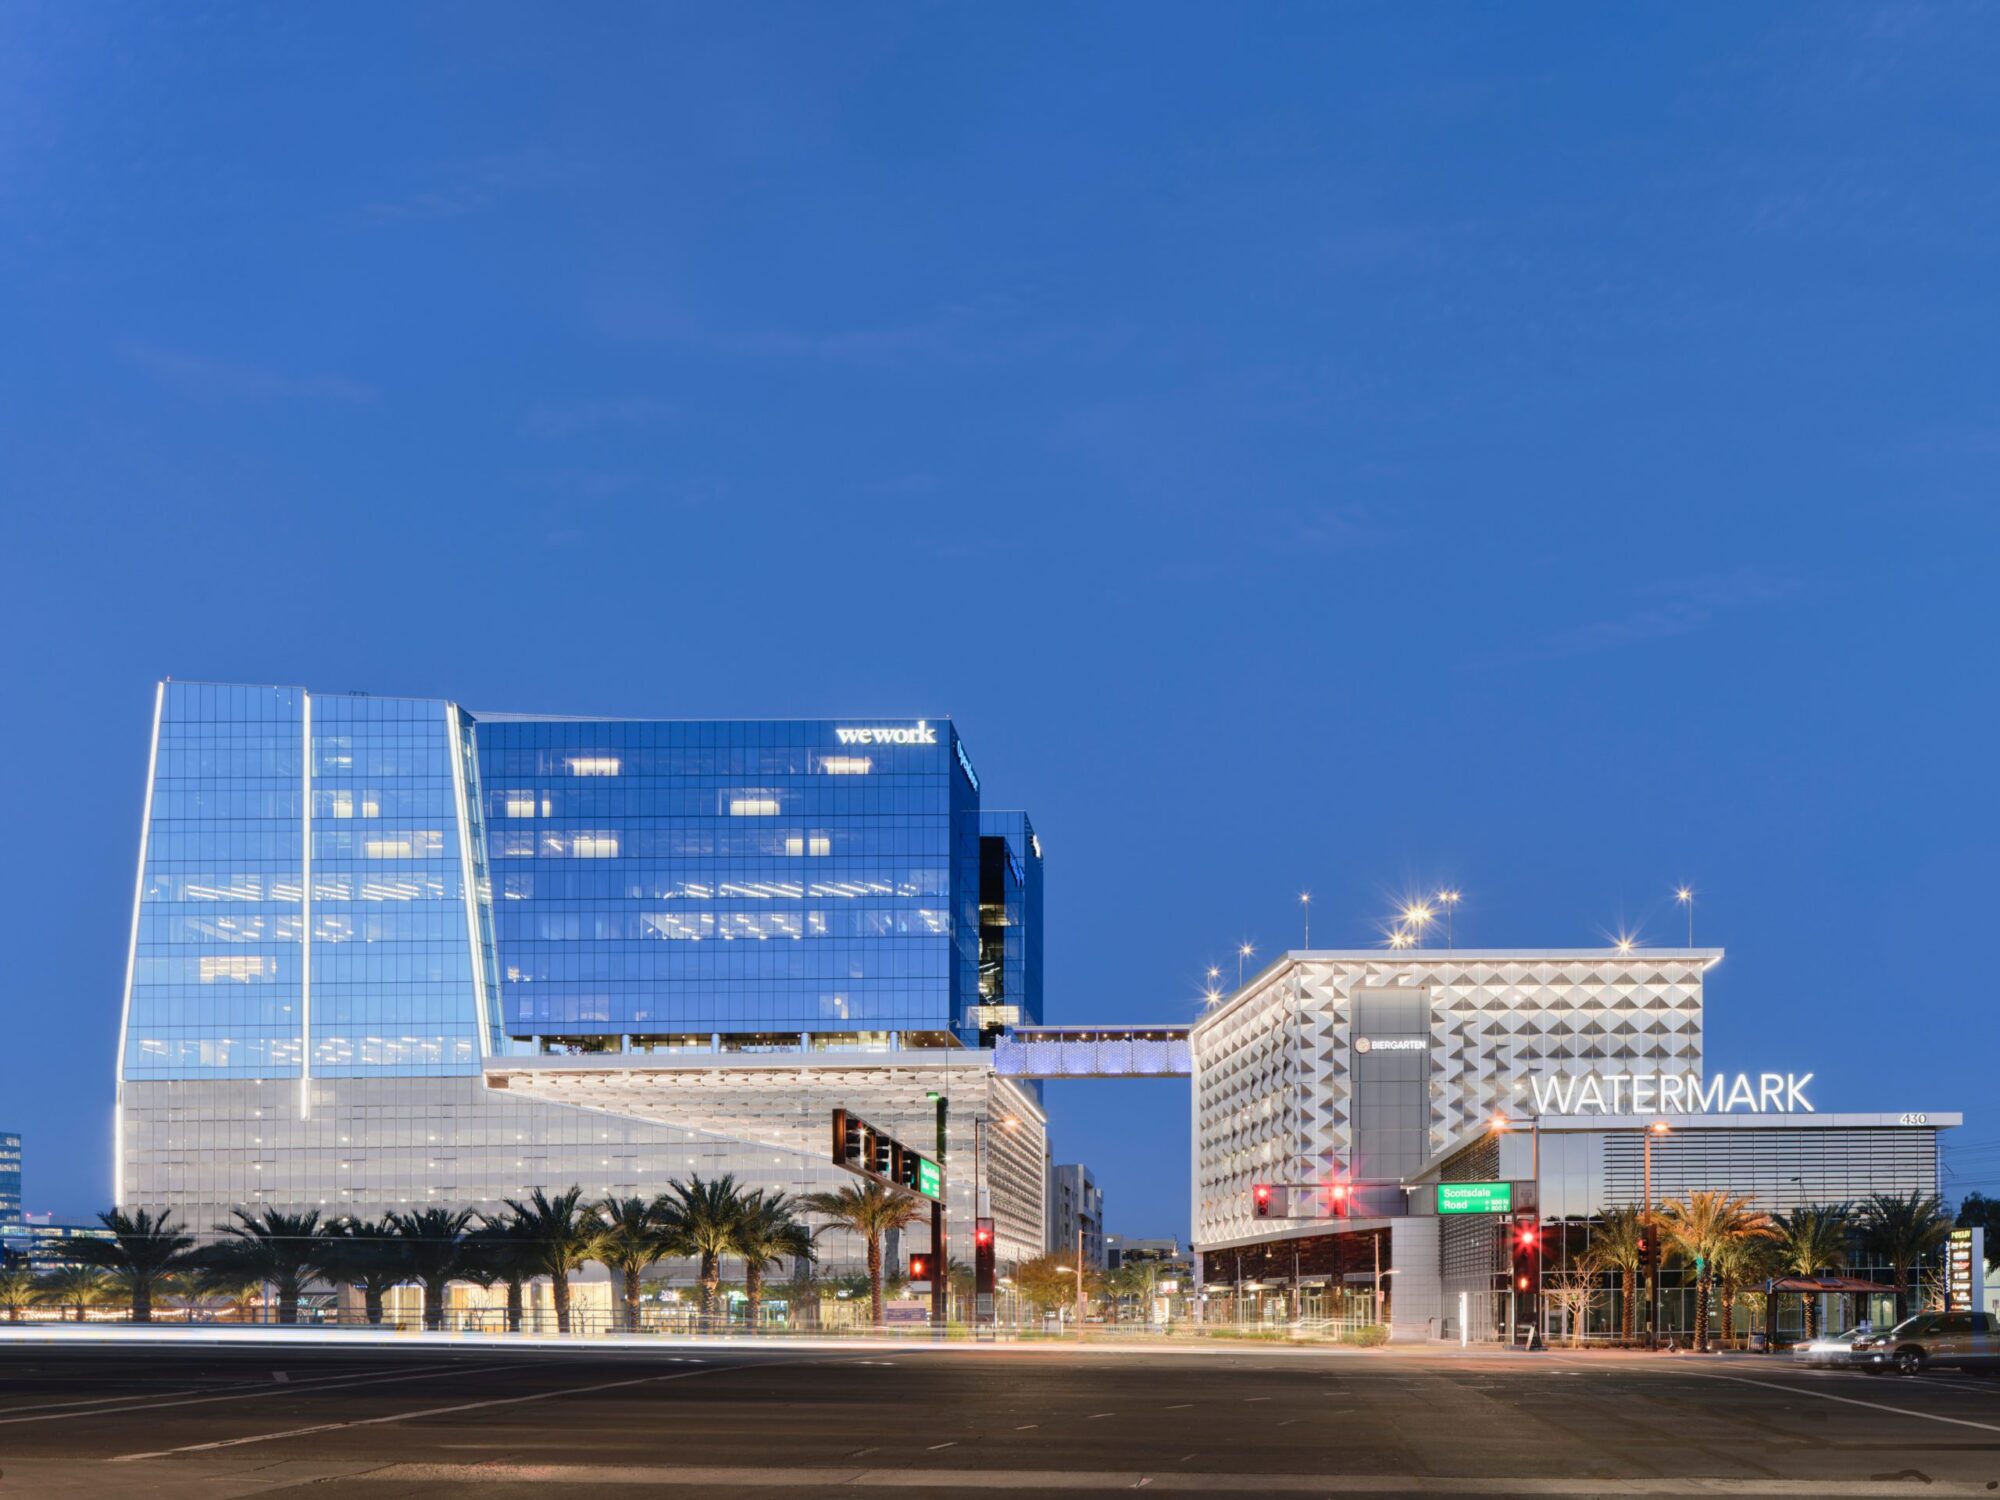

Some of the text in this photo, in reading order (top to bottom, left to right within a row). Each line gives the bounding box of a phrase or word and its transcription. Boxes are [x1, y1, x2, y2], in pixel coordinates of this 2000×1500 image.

[836, 720, 937, 744] wework
[1371, 1040, 1426, 1050] BIERGARTEN
[1530, 1073, 1815, 1114] WATERMARK
[1901, 1113, 1928, 1125] 430
[1443, 1187, 1491, 1198] Scottsdale
[1443, 1200, 1468, 1210] Road
